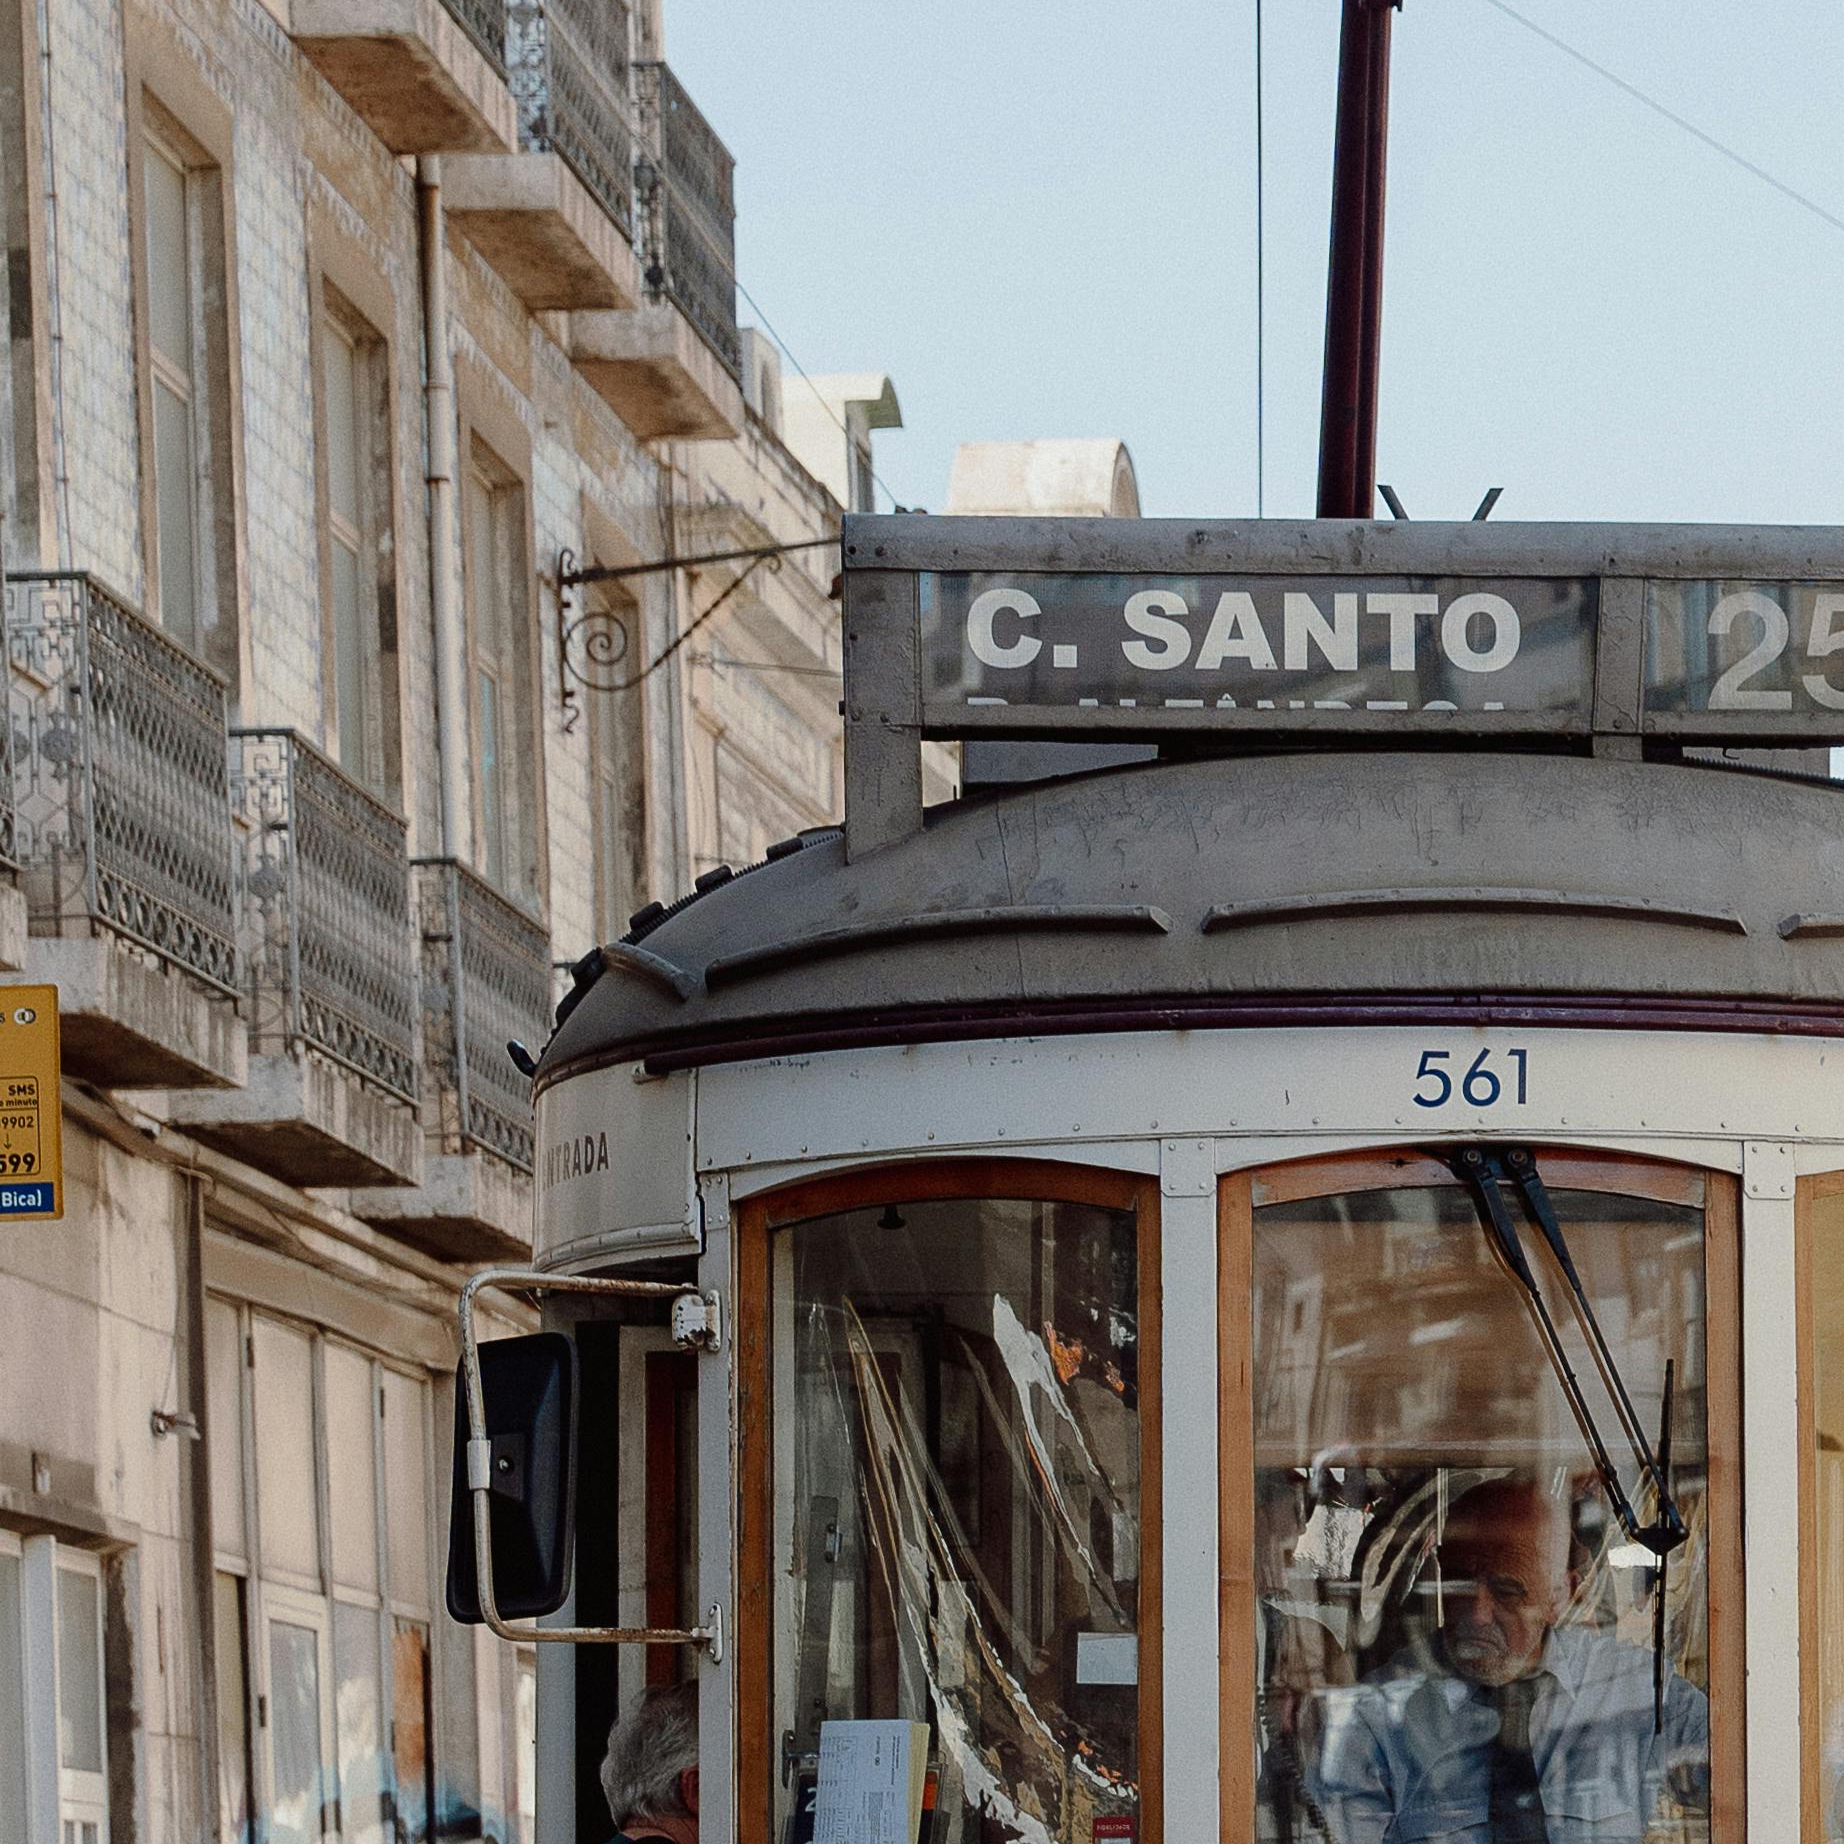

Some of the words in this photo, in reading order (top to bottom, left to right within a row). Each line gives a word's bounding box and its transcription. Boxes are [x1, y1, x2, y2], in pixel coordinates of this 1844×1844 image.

[965, 588, 1078, 672] C.
[1120, 586, 1523, 674] SANTO
[8, 1084, 36, 1097] SMS
[1412, 1046, 1528, 1108] 561
